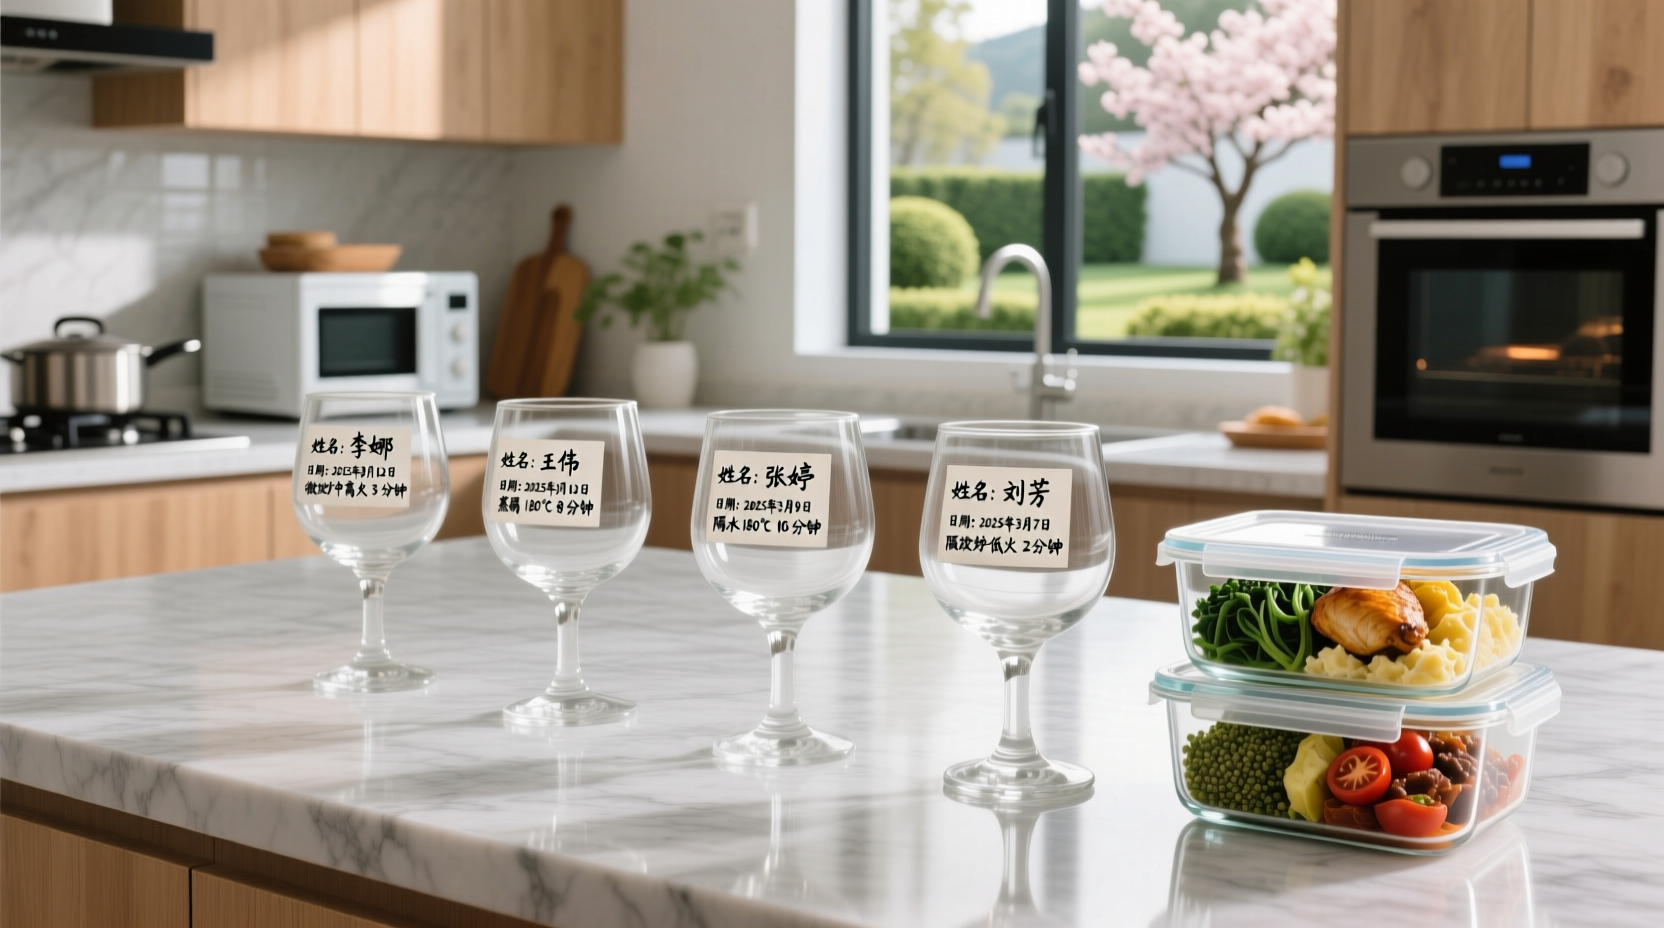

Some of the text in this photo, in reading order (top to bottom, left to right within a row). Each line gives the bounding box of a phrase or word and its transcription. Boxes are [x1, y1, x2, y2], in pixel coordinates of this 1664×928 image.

[350, 431, 394, 462] 李娜
[540, 448, 580, 477] 王伟
[765, 461, 815, 492] 张婷
[1003, 477, 1050, 509] 刘芳
